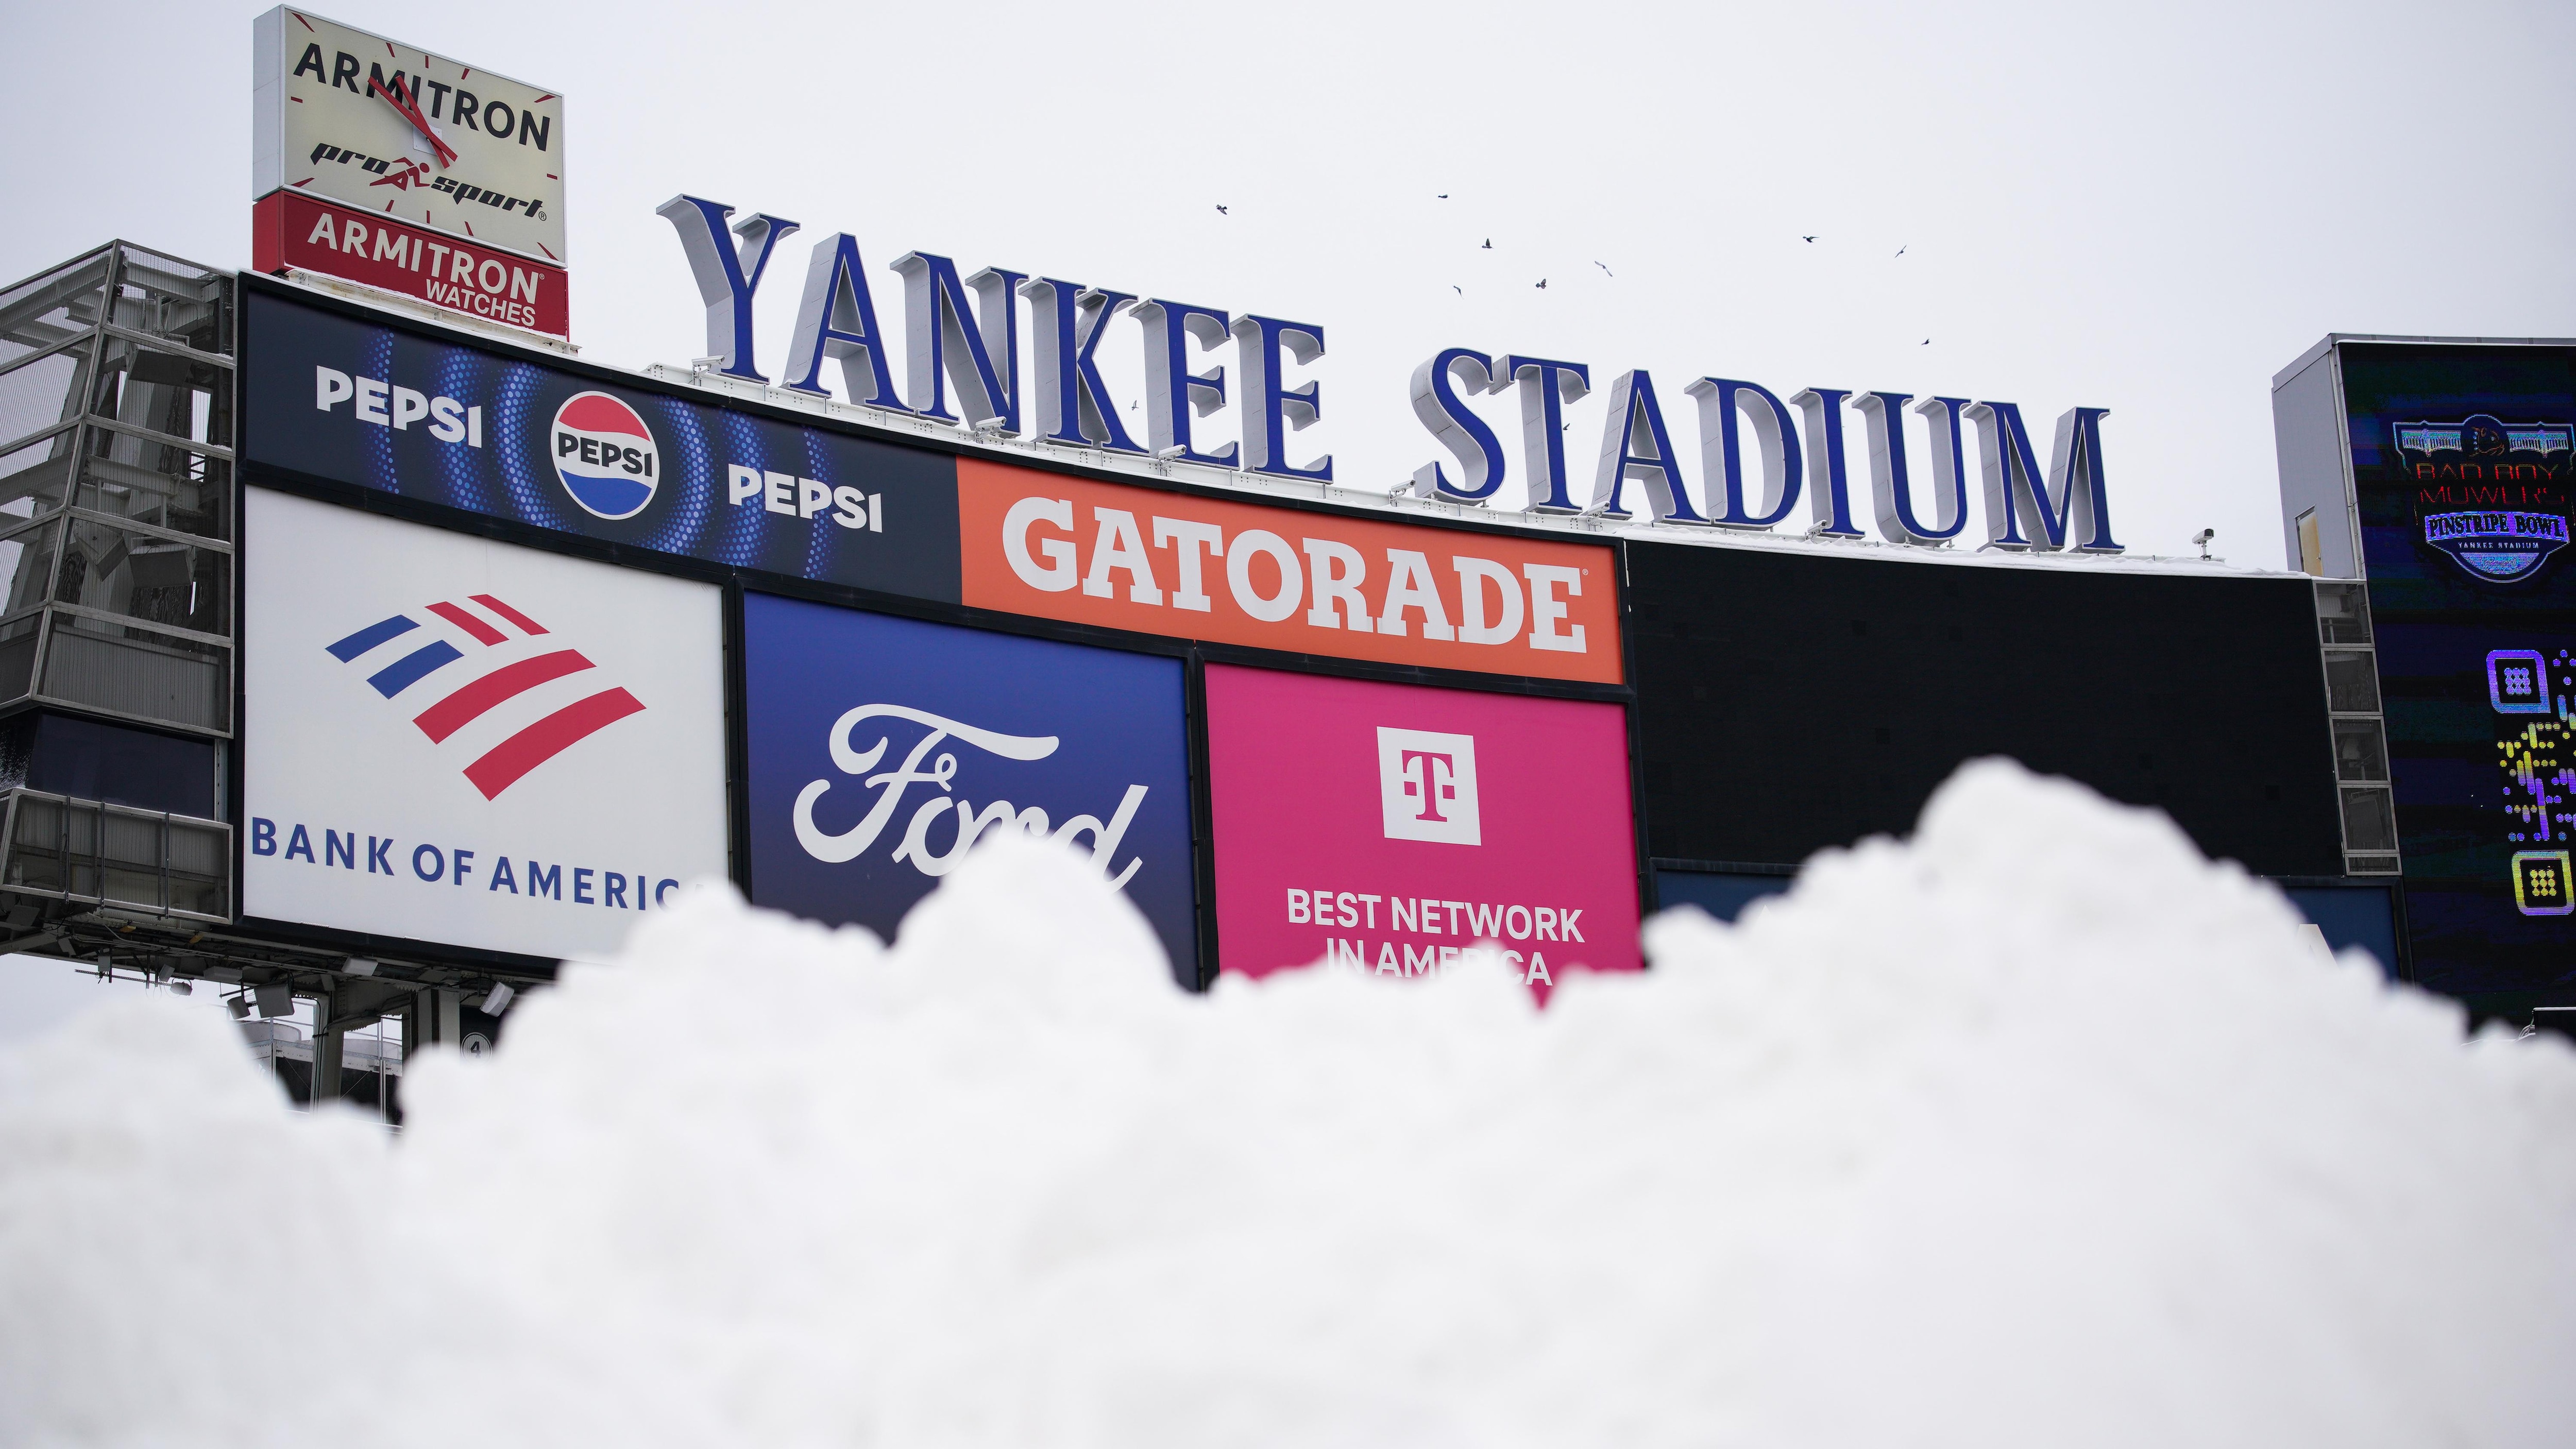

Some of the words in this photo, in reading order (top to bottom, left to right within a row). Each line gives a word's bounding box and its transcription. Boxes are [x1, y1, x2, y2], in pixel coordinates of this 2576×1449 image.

[293, 42, 550, 152] ARMITRON
[310, 143, 391, 175] pro
[426, 279, 536, 327] WATCHES
[677, 193, 1333, 482] YANKEE
[1428, 347, 2126, 554] STADIUM
[316, 365, 482, 449] PEPSI
[558, 432, 652, 478] PEPSI
[728, 463, 883, 533] PEPSI
[2429, 514, 2511, 537] PINSTRIPE
[2514, 514, 2565, 538] BOWL
[252, 817, 395, 876] BANK
[412, 844, 475, 886] OF
[489, 856, 704, 912] AMERIC
[1287, 888, 1382, 929] BEST
[1392, 896, 1586, 943] NETWORK
[1327, 937, 1365, 975] IN
[470, 1041, 481, 1059] 4
